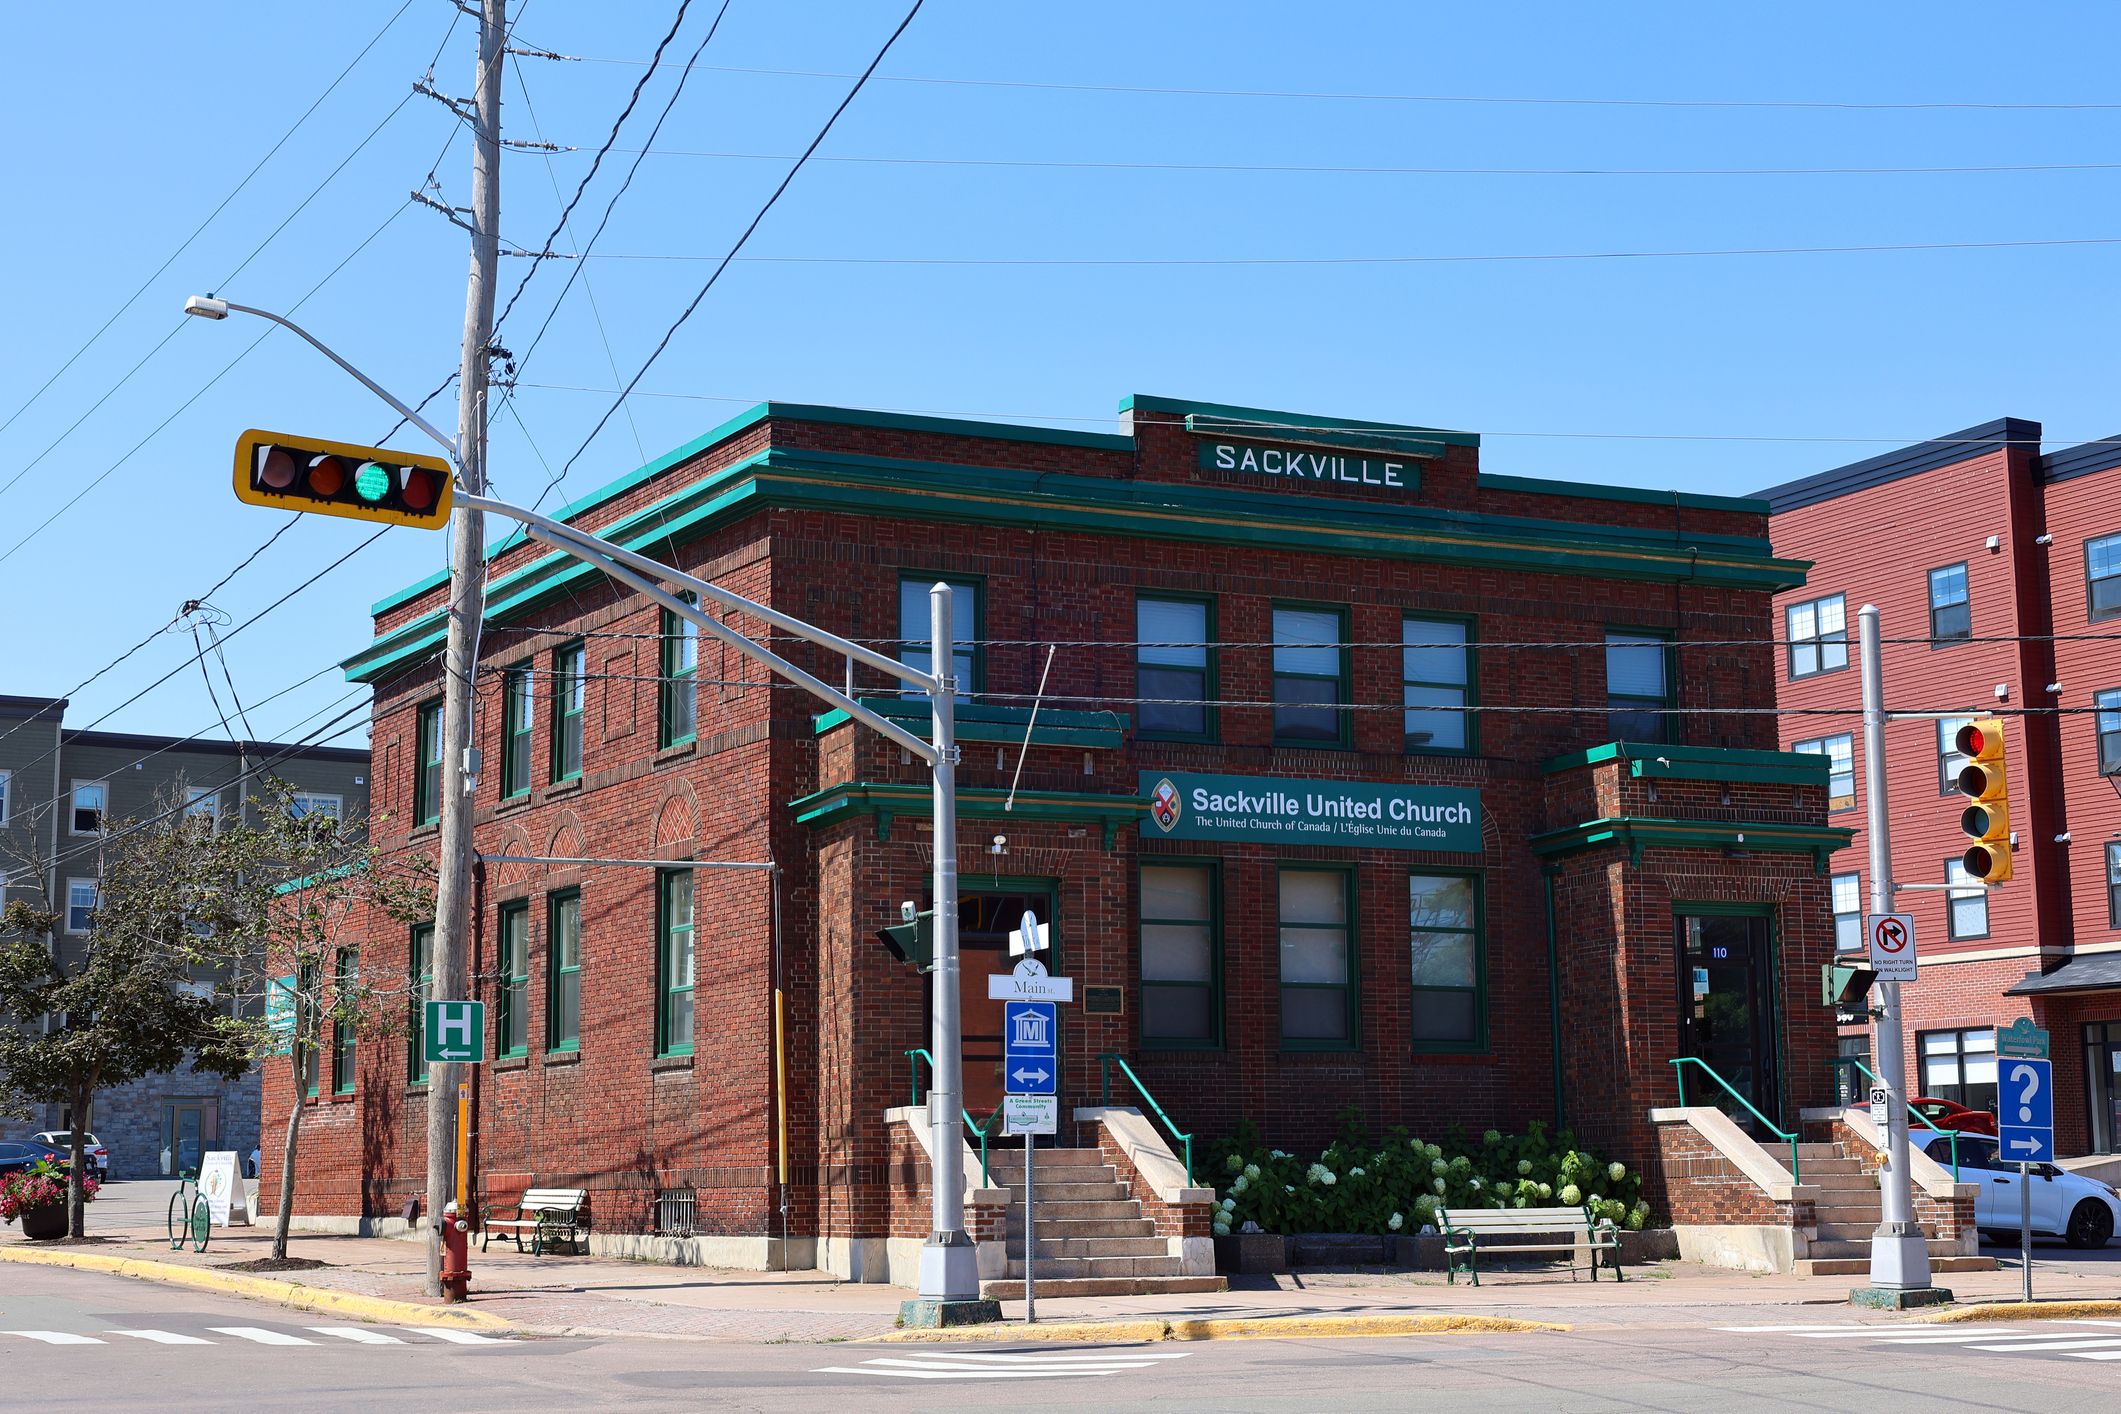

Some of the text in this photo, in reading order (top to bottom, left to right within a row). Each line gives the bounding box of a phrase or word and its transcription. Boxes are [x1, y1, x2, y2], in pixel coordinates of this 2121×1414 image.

[1216, 445, 1403, 487] SACKVILLE
[1192, 788, 1472, 824] Sackville United Church
[1195, 816, 1213, 827] The
[1215, 817, 1247, 829] United
[1250, 818, 1282, 830] Church
[1285, 820, 1296, 831] of
[1298, 820, 1331, 832] Canada
[1376, 825, 1397, 835] Unie
[1400, 825, 1412, 836] du
[1414, 826, 1446, 838] Canada
[1713, 947, 1727, 958] 110
[1014, 981, 1046, 994] Main
[438, 1004, 471, 1045] H
[1023, 1021, 1039, 1040] M
